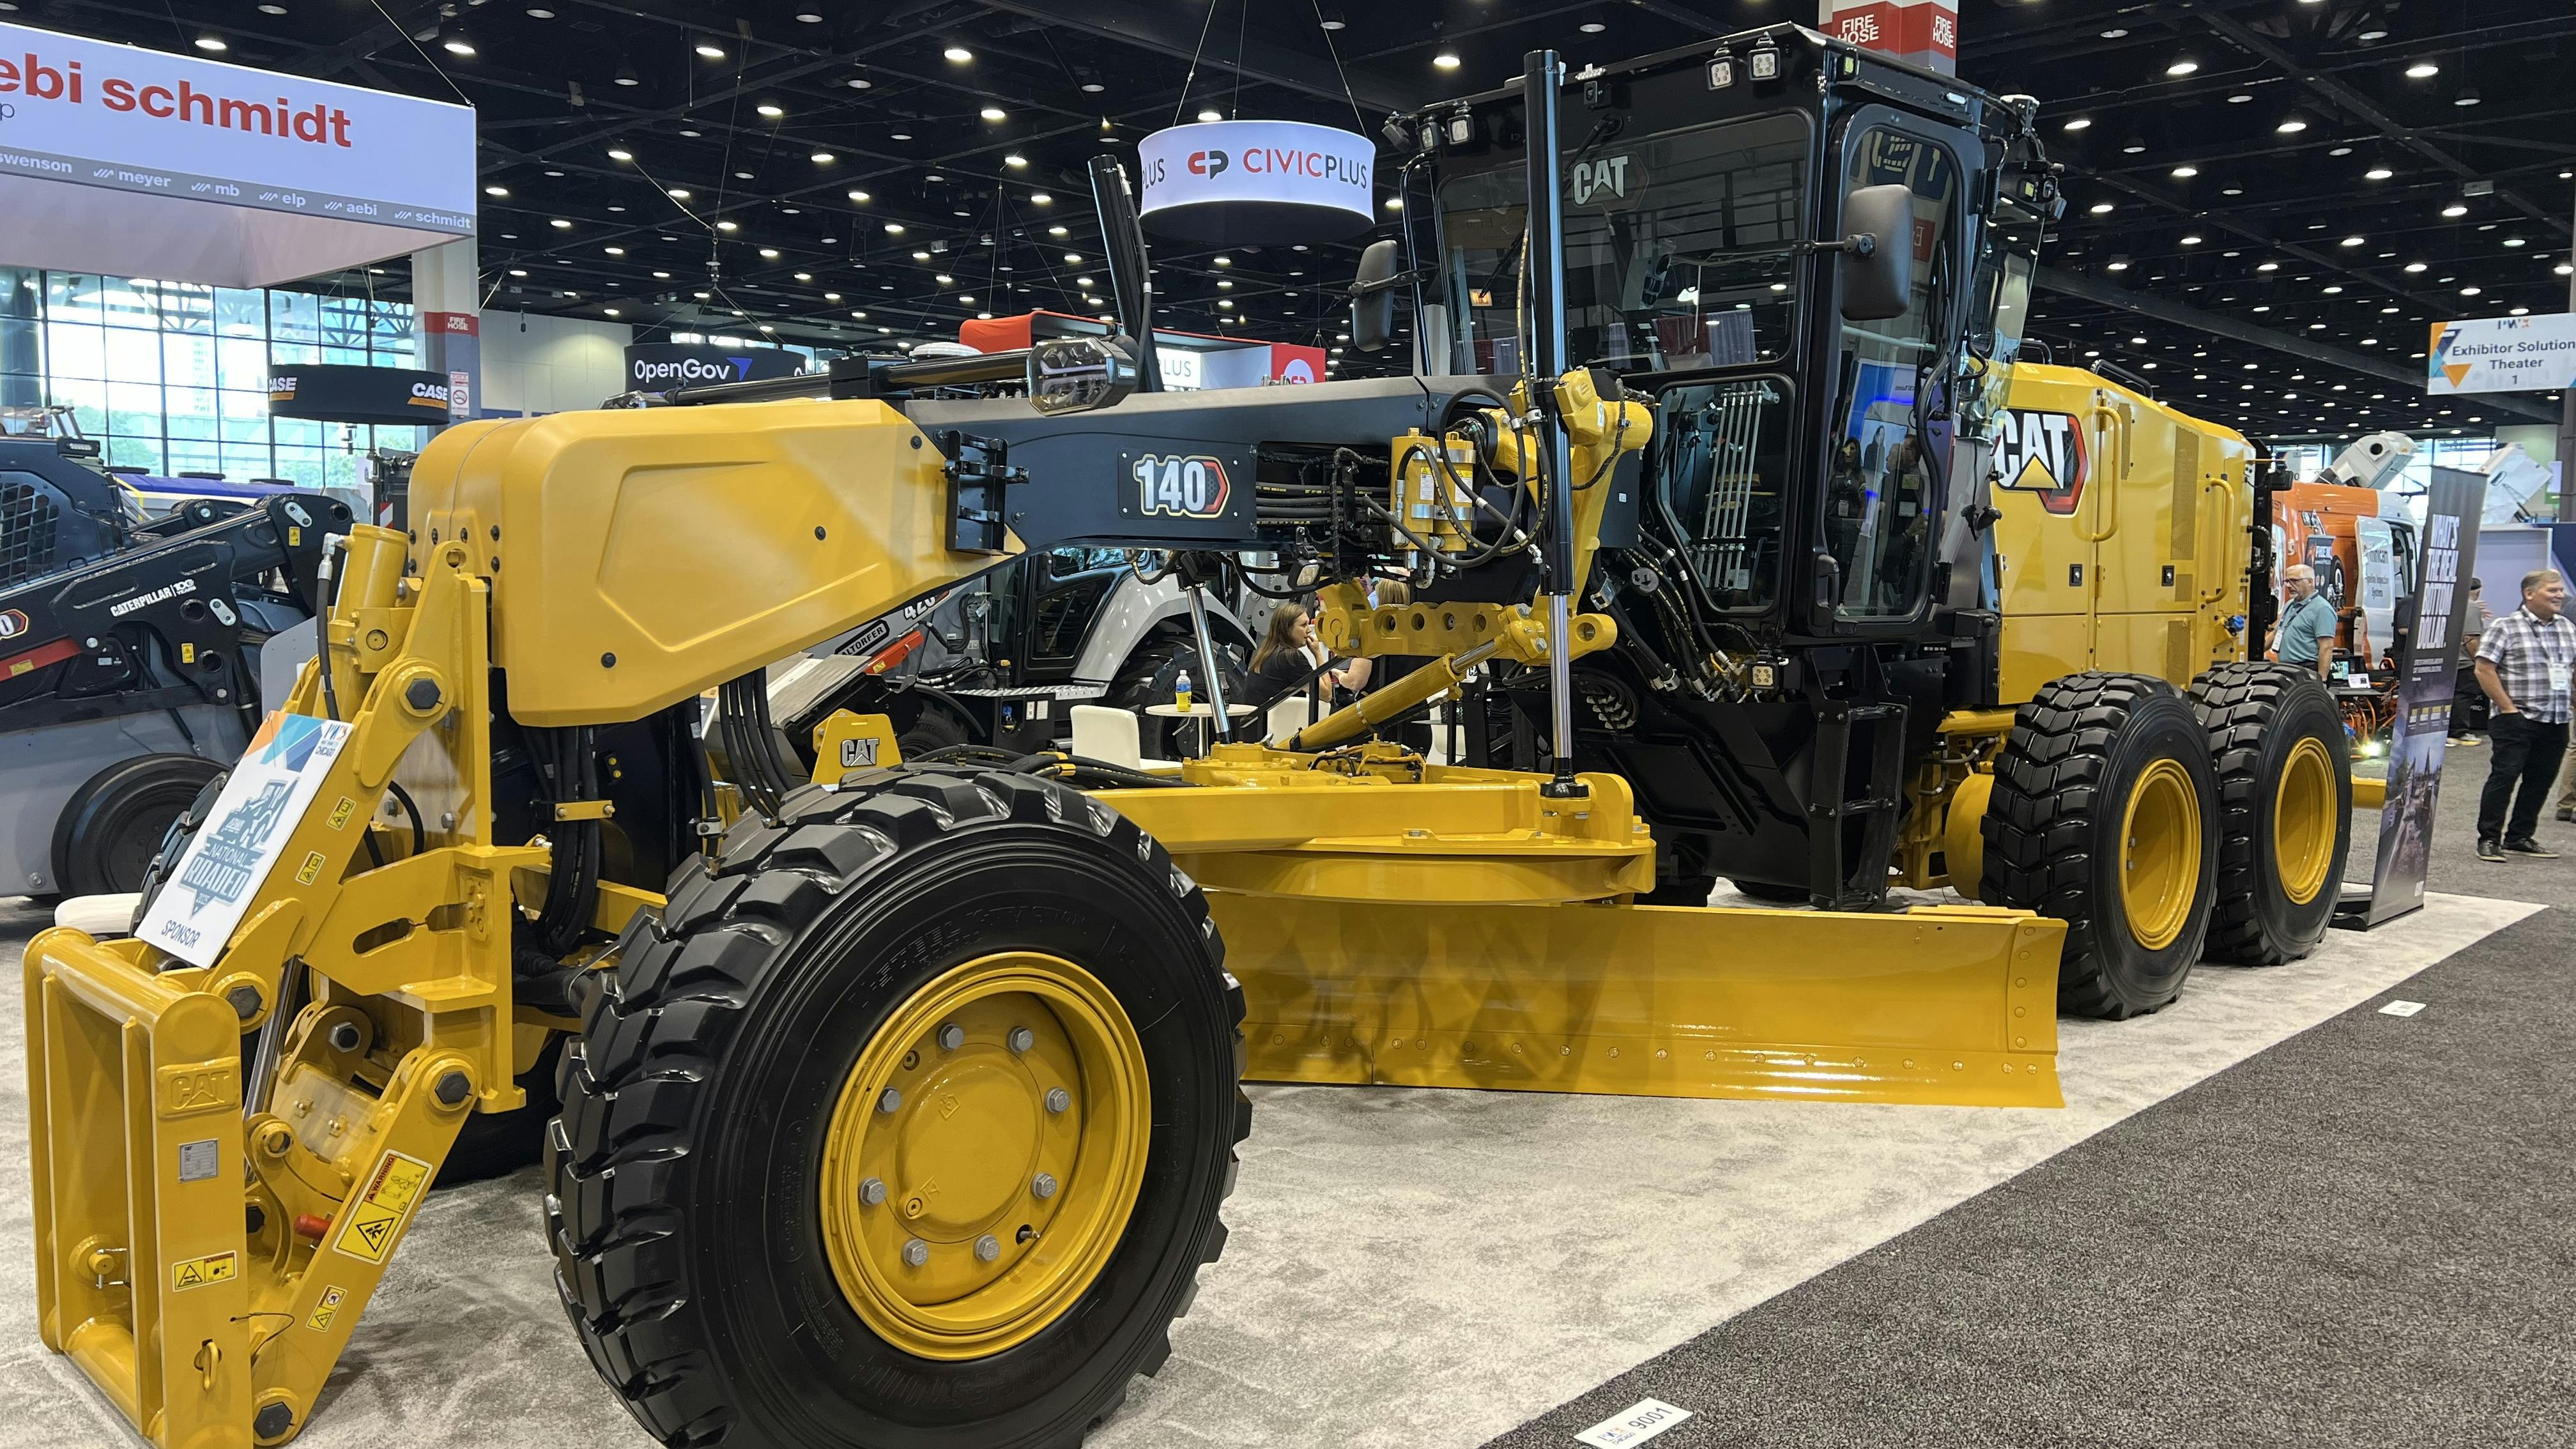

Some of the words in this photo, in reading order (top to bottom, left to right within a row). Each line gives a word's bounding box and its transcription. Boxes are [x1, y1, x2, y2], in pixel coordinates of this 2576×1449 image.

[1837, 26, 1880, 45] HOSE
[1841, 14, 1875, 33] FIRE
[1935, 15, 1952, 34] FIRE
[1933, 27, 1954, 49] HOSE
[102, 78, 352, 148] schmidt
[1243, 148, 1367, 190] CIVICPLUS
[1573, 155, 1629, 205] CAT
[118, 169, 172, 188] meyer
[215, 183, 240, 197] mb
[282, 191, 307, 208] elp
[346, 202, 378, 216] aebi
[415, 211, 471, 229] schmidt
[447, 322, 469, 331] HOSE
[2452, 344, 2513, 356] Exhibitor
[2518, 339, 2575, 352] Solution
[634, 358, 730, 383] OpenGov
[1159, 360, 1192, 378] LUS
[2490, 358, 2544, 370] Theater
[269, 377, 298, 393] ASE
[412, 382, 448, 401] CASE
[2512, 374, 2518, 384] 1
[1992, 410, 2069, 489] CAT
[1137, 459, 1206, 512] 140
[2425, 548, 2442, 582] THE
[2439, 548, 2459, 583] REAL
[110, 586, 172, 617] CATERPILLAR
[2421, 582, 2455, 616] BOTTOM
[841, 626, 884, 656] ALTORFER
[841, 738, 880, 767] CAT
[209, 843, 249, 867] NATIONAL
[161, 919, 201, 949] SPONSOR
[170, 1070, 231, 1110] CAT
[372, 1156, 395, 1192] WARNING
[1627, 1407, 1673, 1429] 9001
